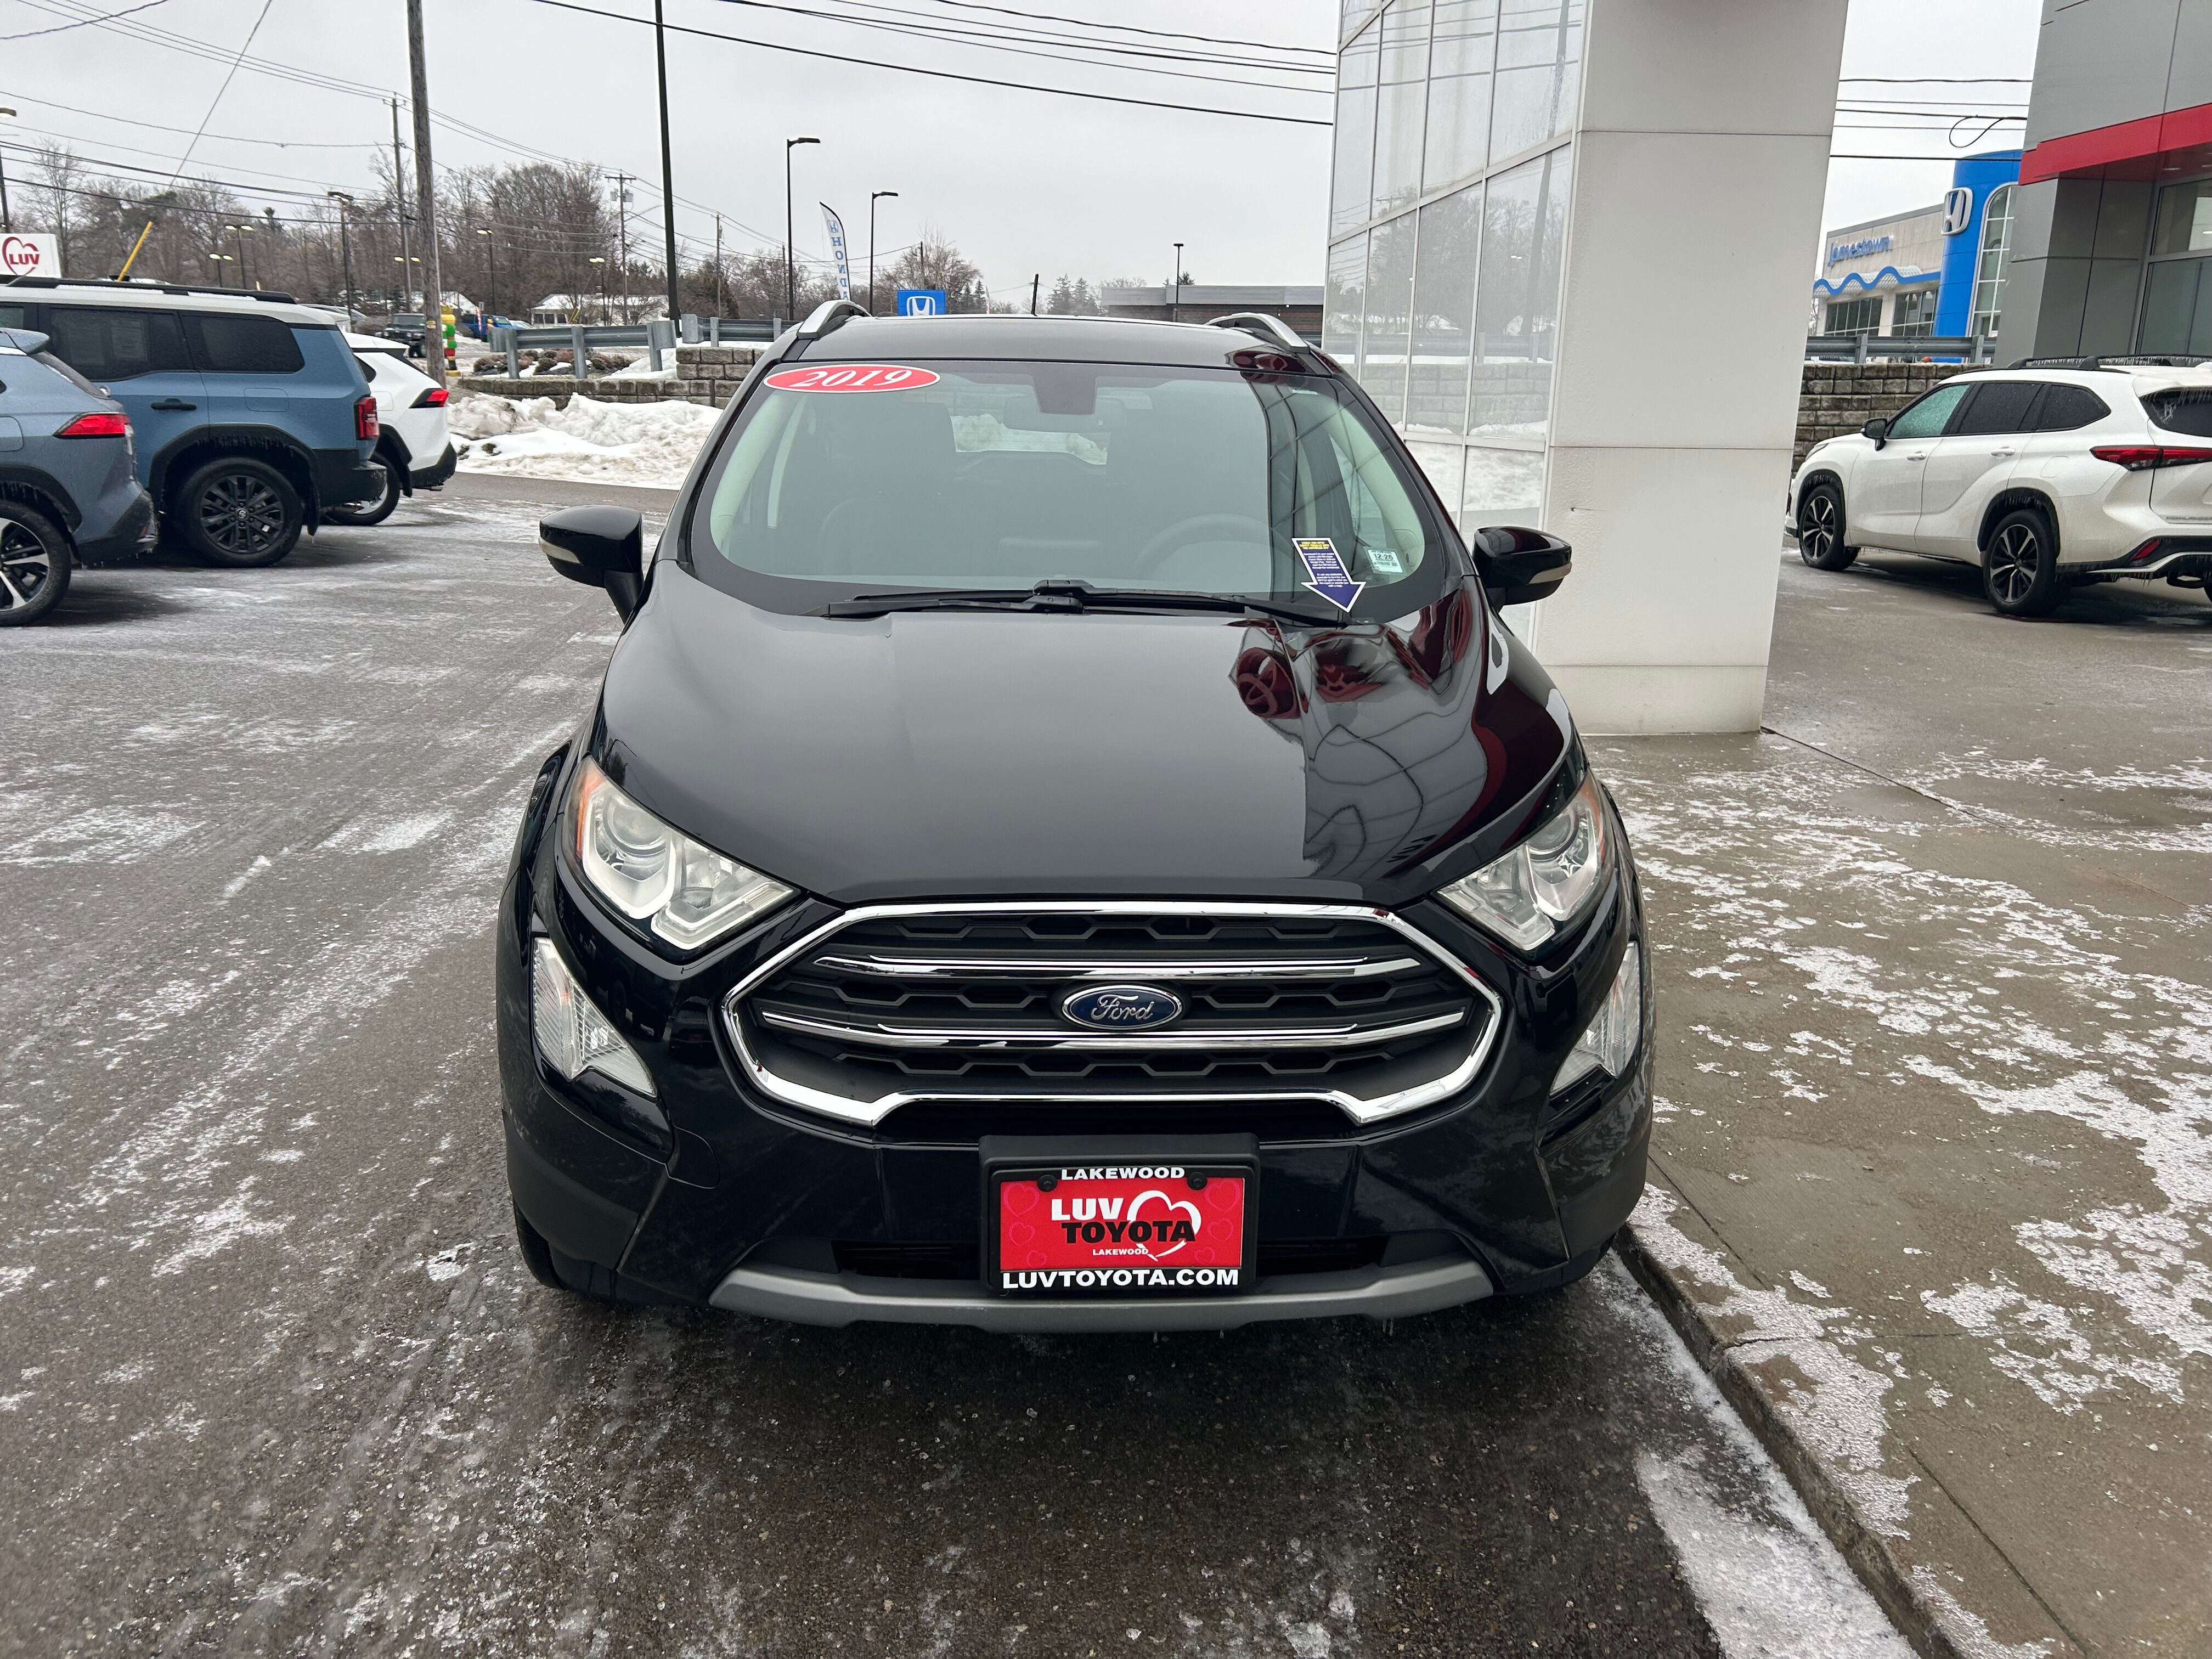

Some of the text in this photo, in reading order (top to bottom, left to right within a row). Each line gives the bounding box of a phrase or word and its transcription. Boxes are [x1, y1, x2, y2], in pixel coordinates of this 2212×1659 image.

[9, 253, 40, 264] LUV
[1827, 236, 1889, 267] Jamestown
[789, 370, 912, 387] 2019
[1091, 994, 1154, 1020] Ford
[1061, 1167, 1185, 1180] LAKEWOOD
[1051, 1198, 1124, 1221] LUV
[1062, 1221, 1195, 1243] TOYOTA
[1003, 1269, 1238, 1289] LUVTOYOTA.COM
